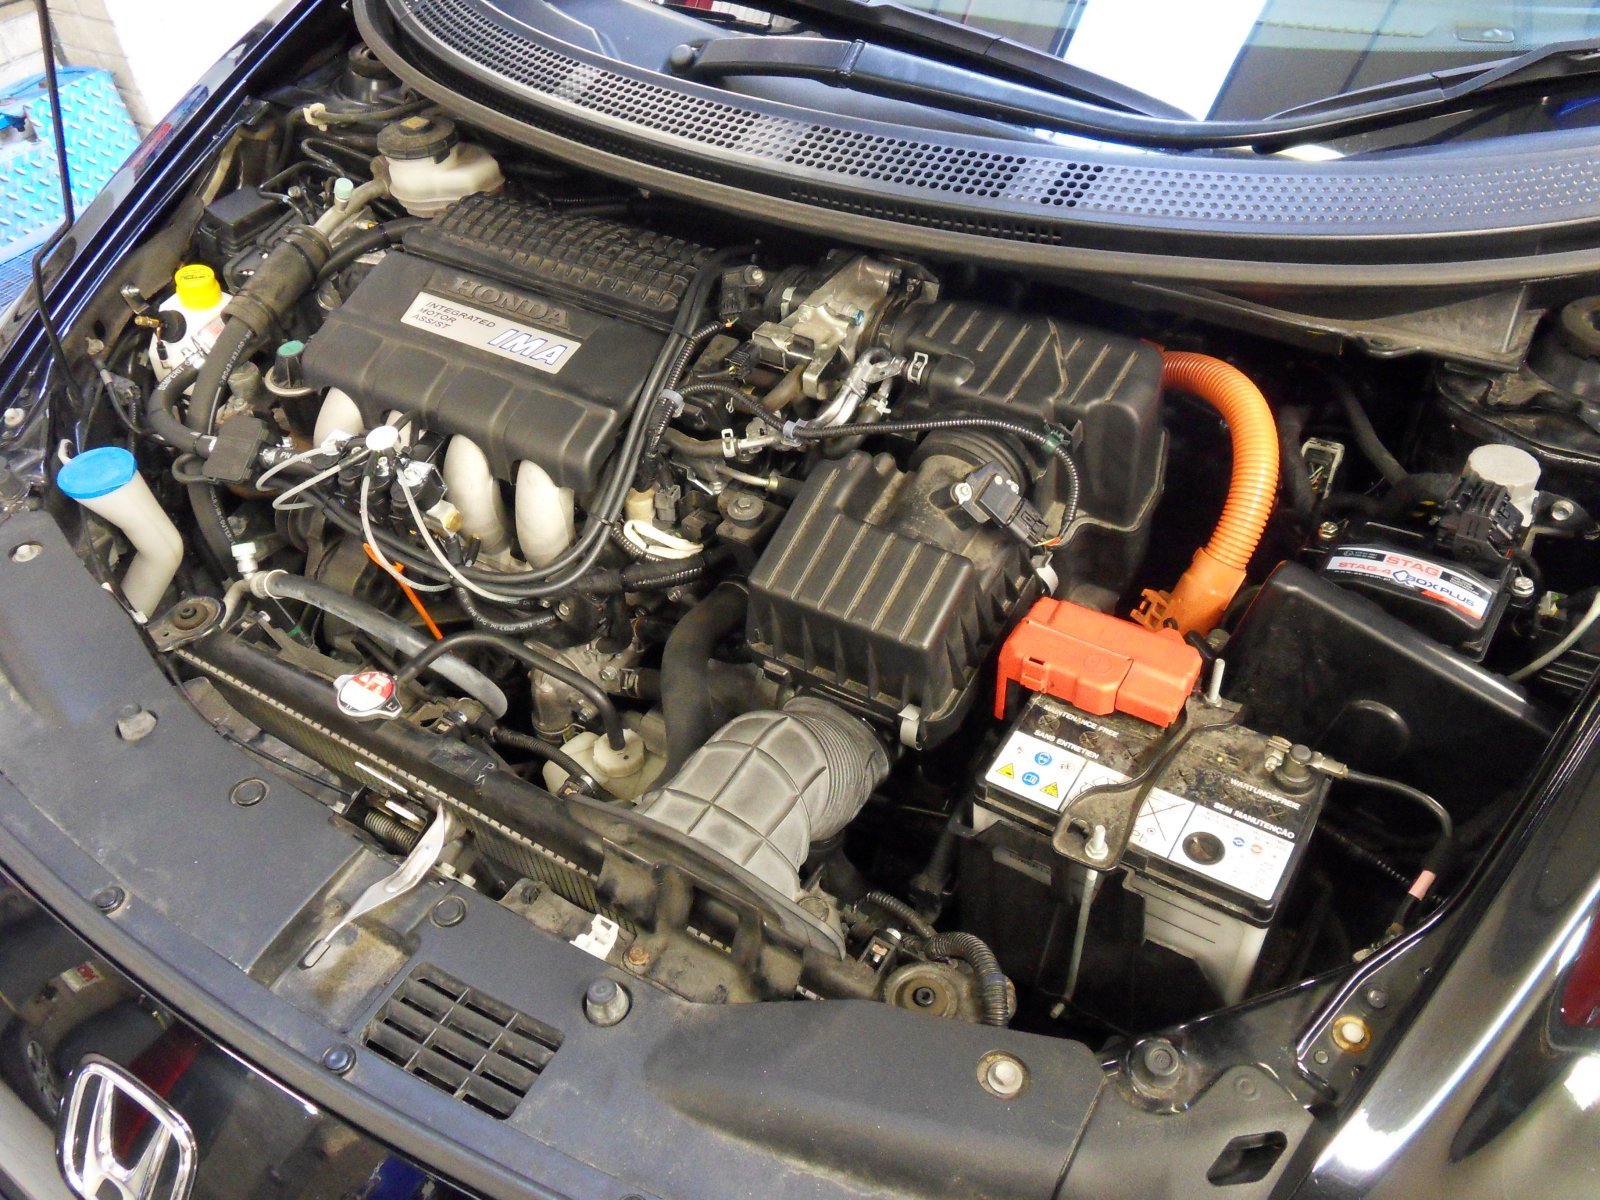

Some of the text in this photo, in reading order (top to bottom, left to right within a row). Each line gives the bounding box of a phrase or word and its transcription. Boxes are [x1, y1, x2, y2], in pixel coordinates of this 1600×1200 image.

[418, 307, 457, 324] MOTOR
[426, 301, 496, 328] INTEGRATED
[450, 277, 569, 330] HONDA
[412, 314, 451, 329] ASSIST
[487, 328, 568, 366] IMA
[1338, 561, 1391, 577] STAG-4
[1384, 555, 1440, 577] STAG
[1440, 587, 1475, 607] PLUS
[1043, 704, 1120, 738] MAINTENANCE FREE
[1034, 729, 1100, 760] SANS ENTRETIEN
[1230, 777, 1301, 811] WARTUNGSFREIE
[1213, 801, 1233, 814] SEM
[1233, 810, 1295, 840] MANUTENÇÃO
